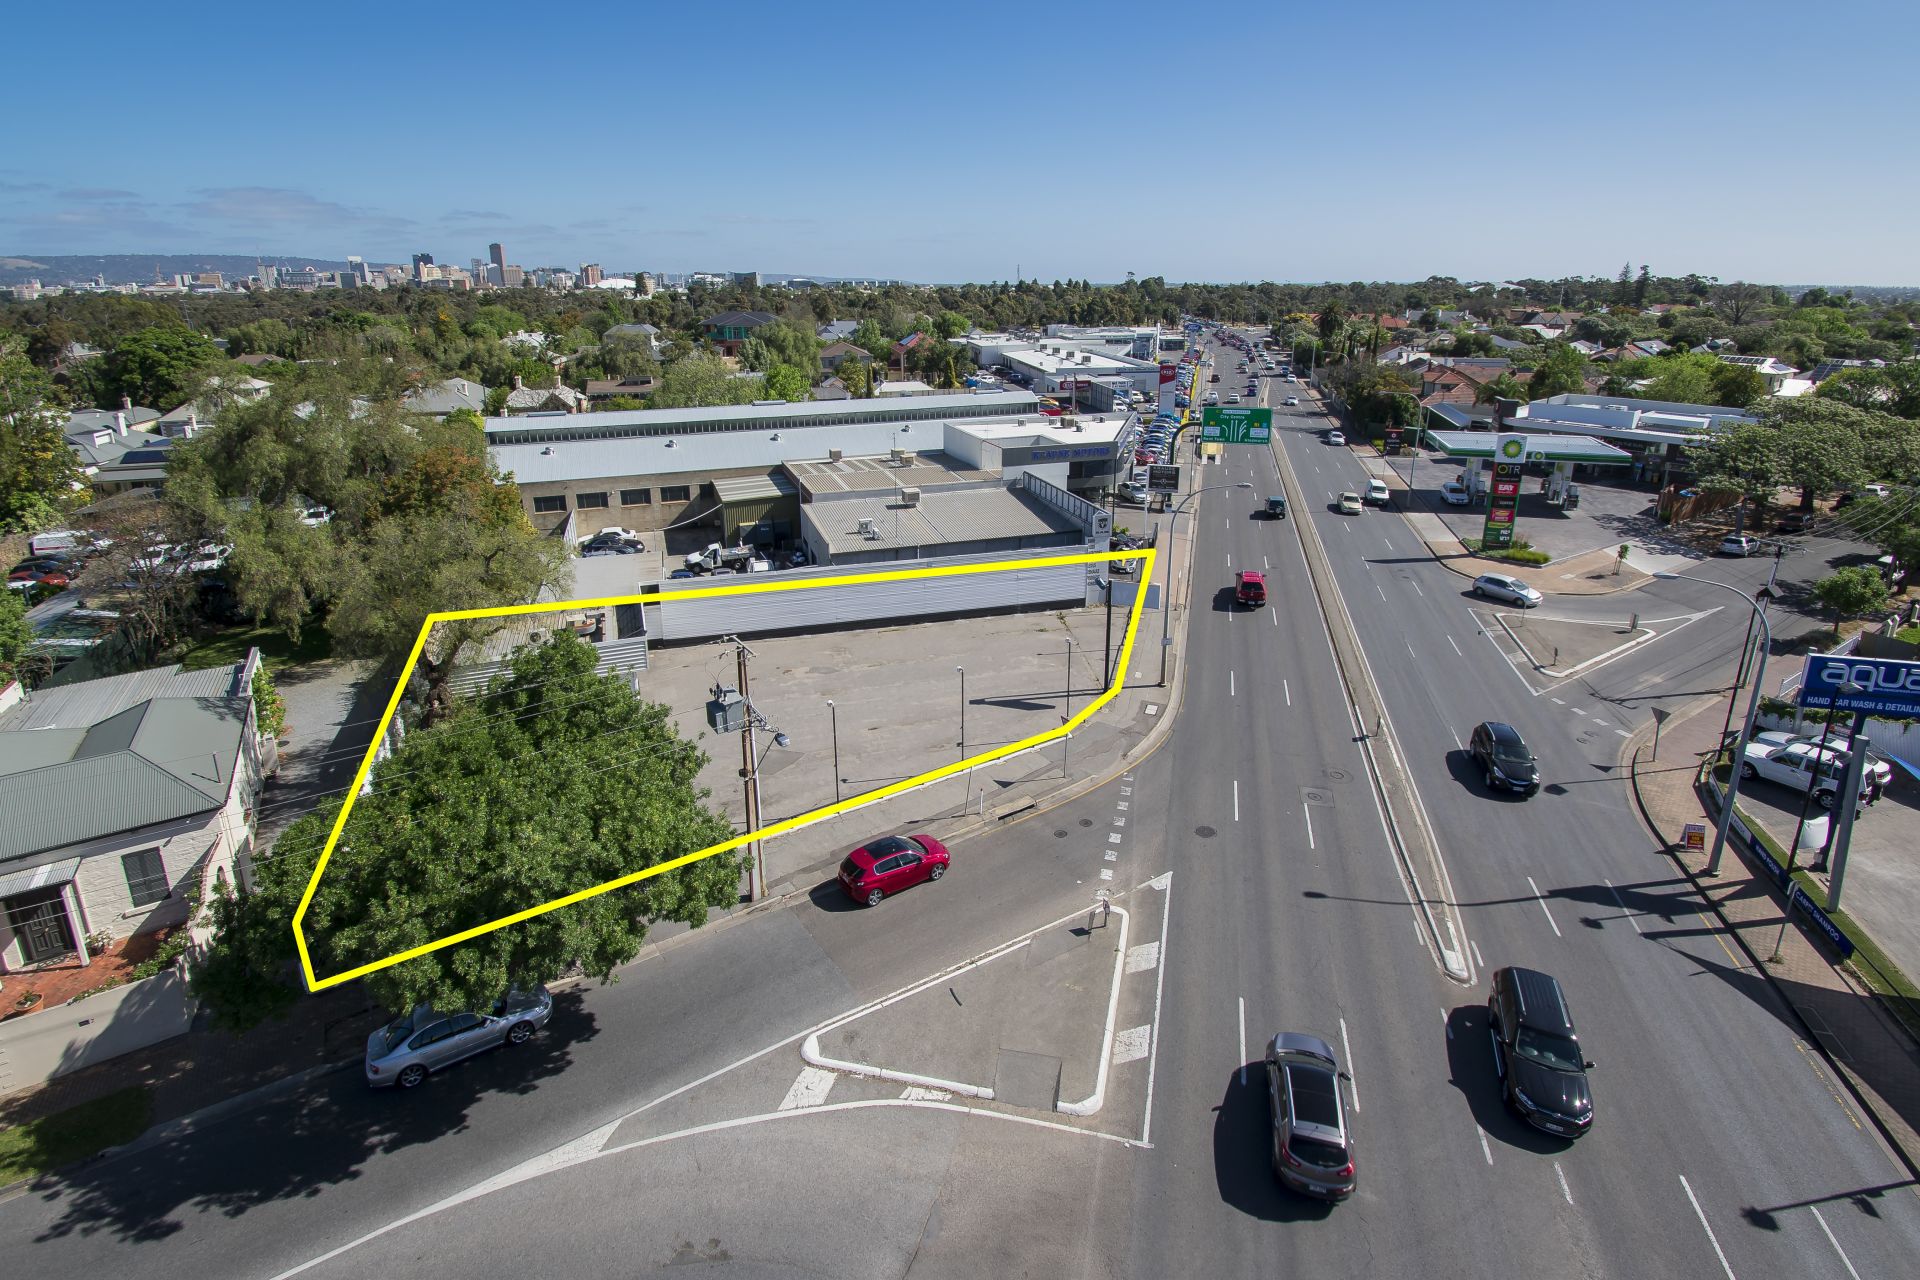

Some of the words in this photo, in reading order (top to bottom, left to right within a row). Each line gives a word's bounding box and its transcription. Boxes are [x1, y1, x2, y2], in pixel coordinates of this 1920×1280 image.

[1498, 464, 1520, 474] OTR
[1807, 696, 1830, 705] HAND
[1850, 700, 1875, 709] WASH
[1876, 702, 1884, 710] &
[1812, 910, 1840, 941] SHAMPOO
